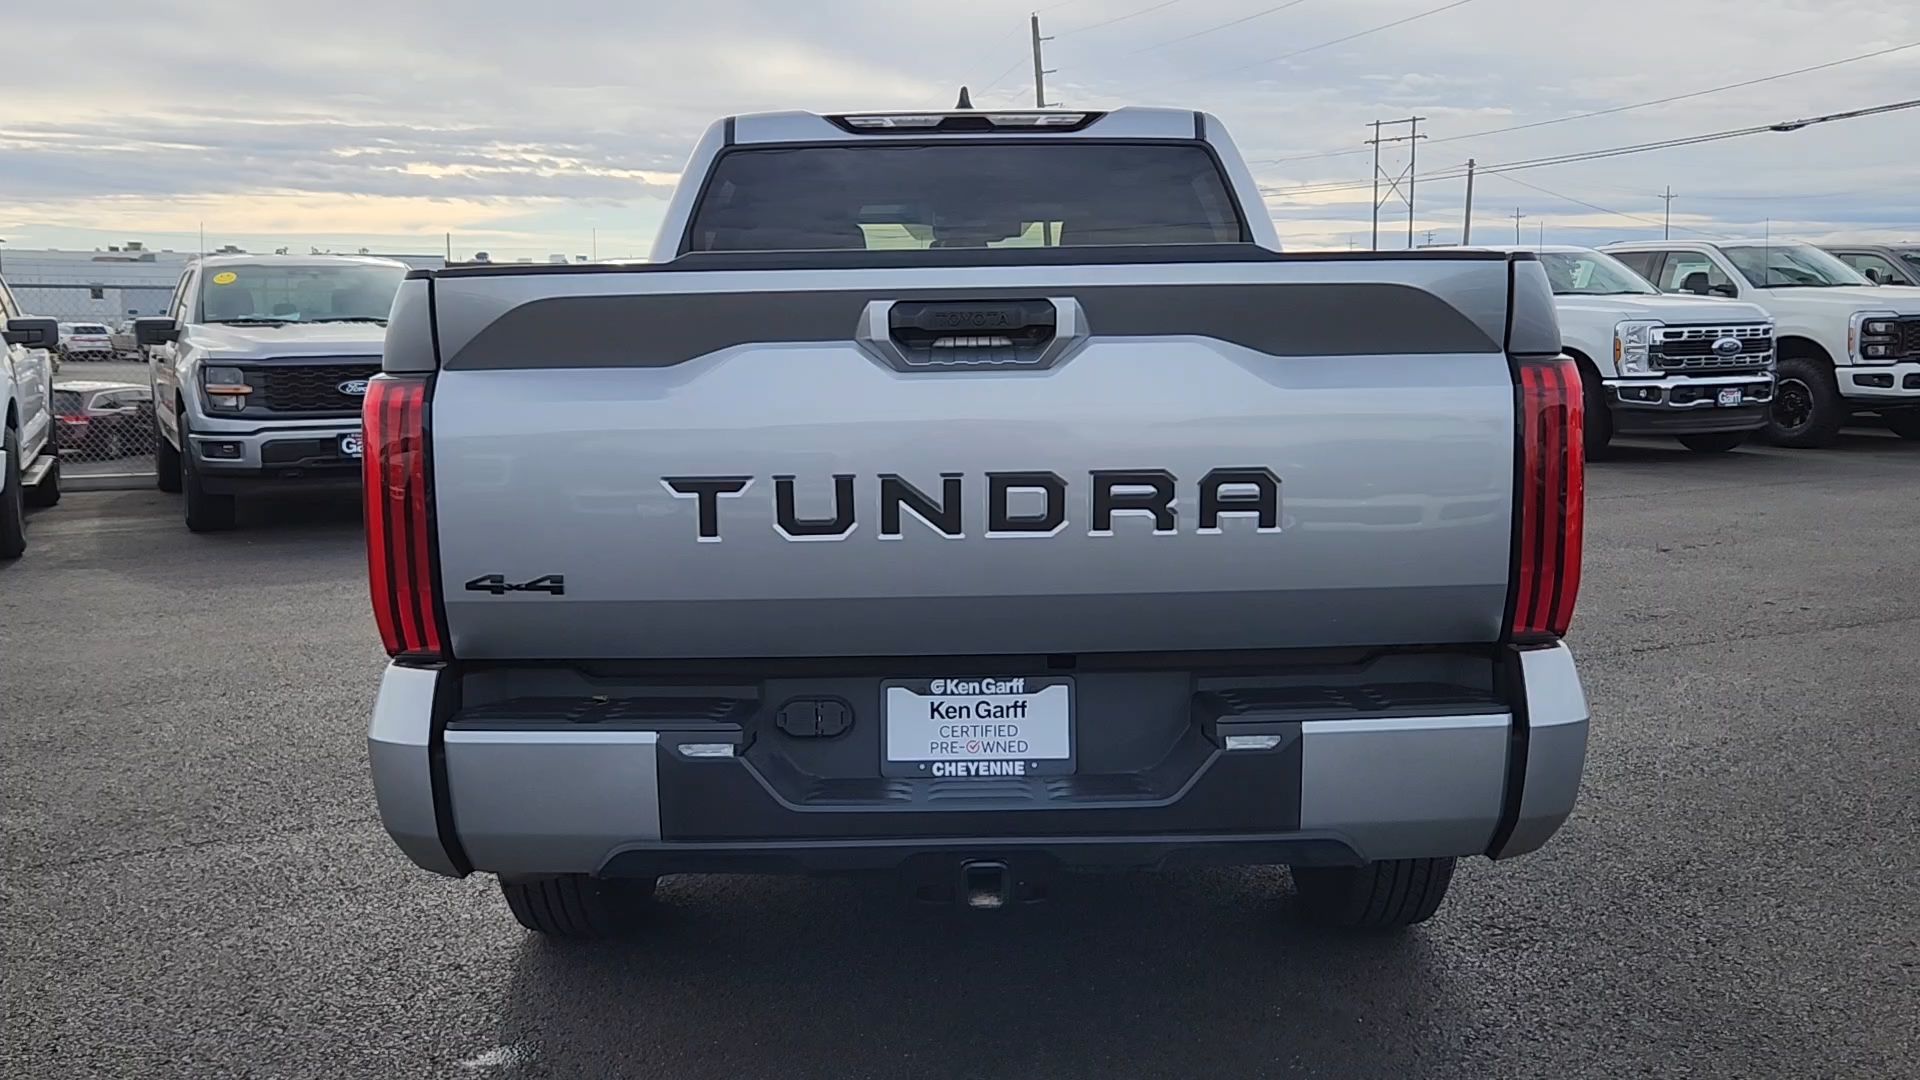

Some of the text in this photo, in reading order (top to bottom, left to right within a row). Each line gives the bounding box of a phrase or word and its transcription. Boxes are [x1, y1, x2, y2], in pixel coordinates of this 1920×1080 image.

[936, 311, 1009, 326] TOYOTA
[660, 466, 1284, 545] TUNDRA
[465, 574, 564, 595] 4x4
[946, 679, 980, 695] Ken
[981, 678, 1025, 694] Garff
[929, 700, 1027, 720] Ken Garff
[939, 725, 1018, 738] CERTIFIED
[931, 761, 1025, 776] CHEYENNE
